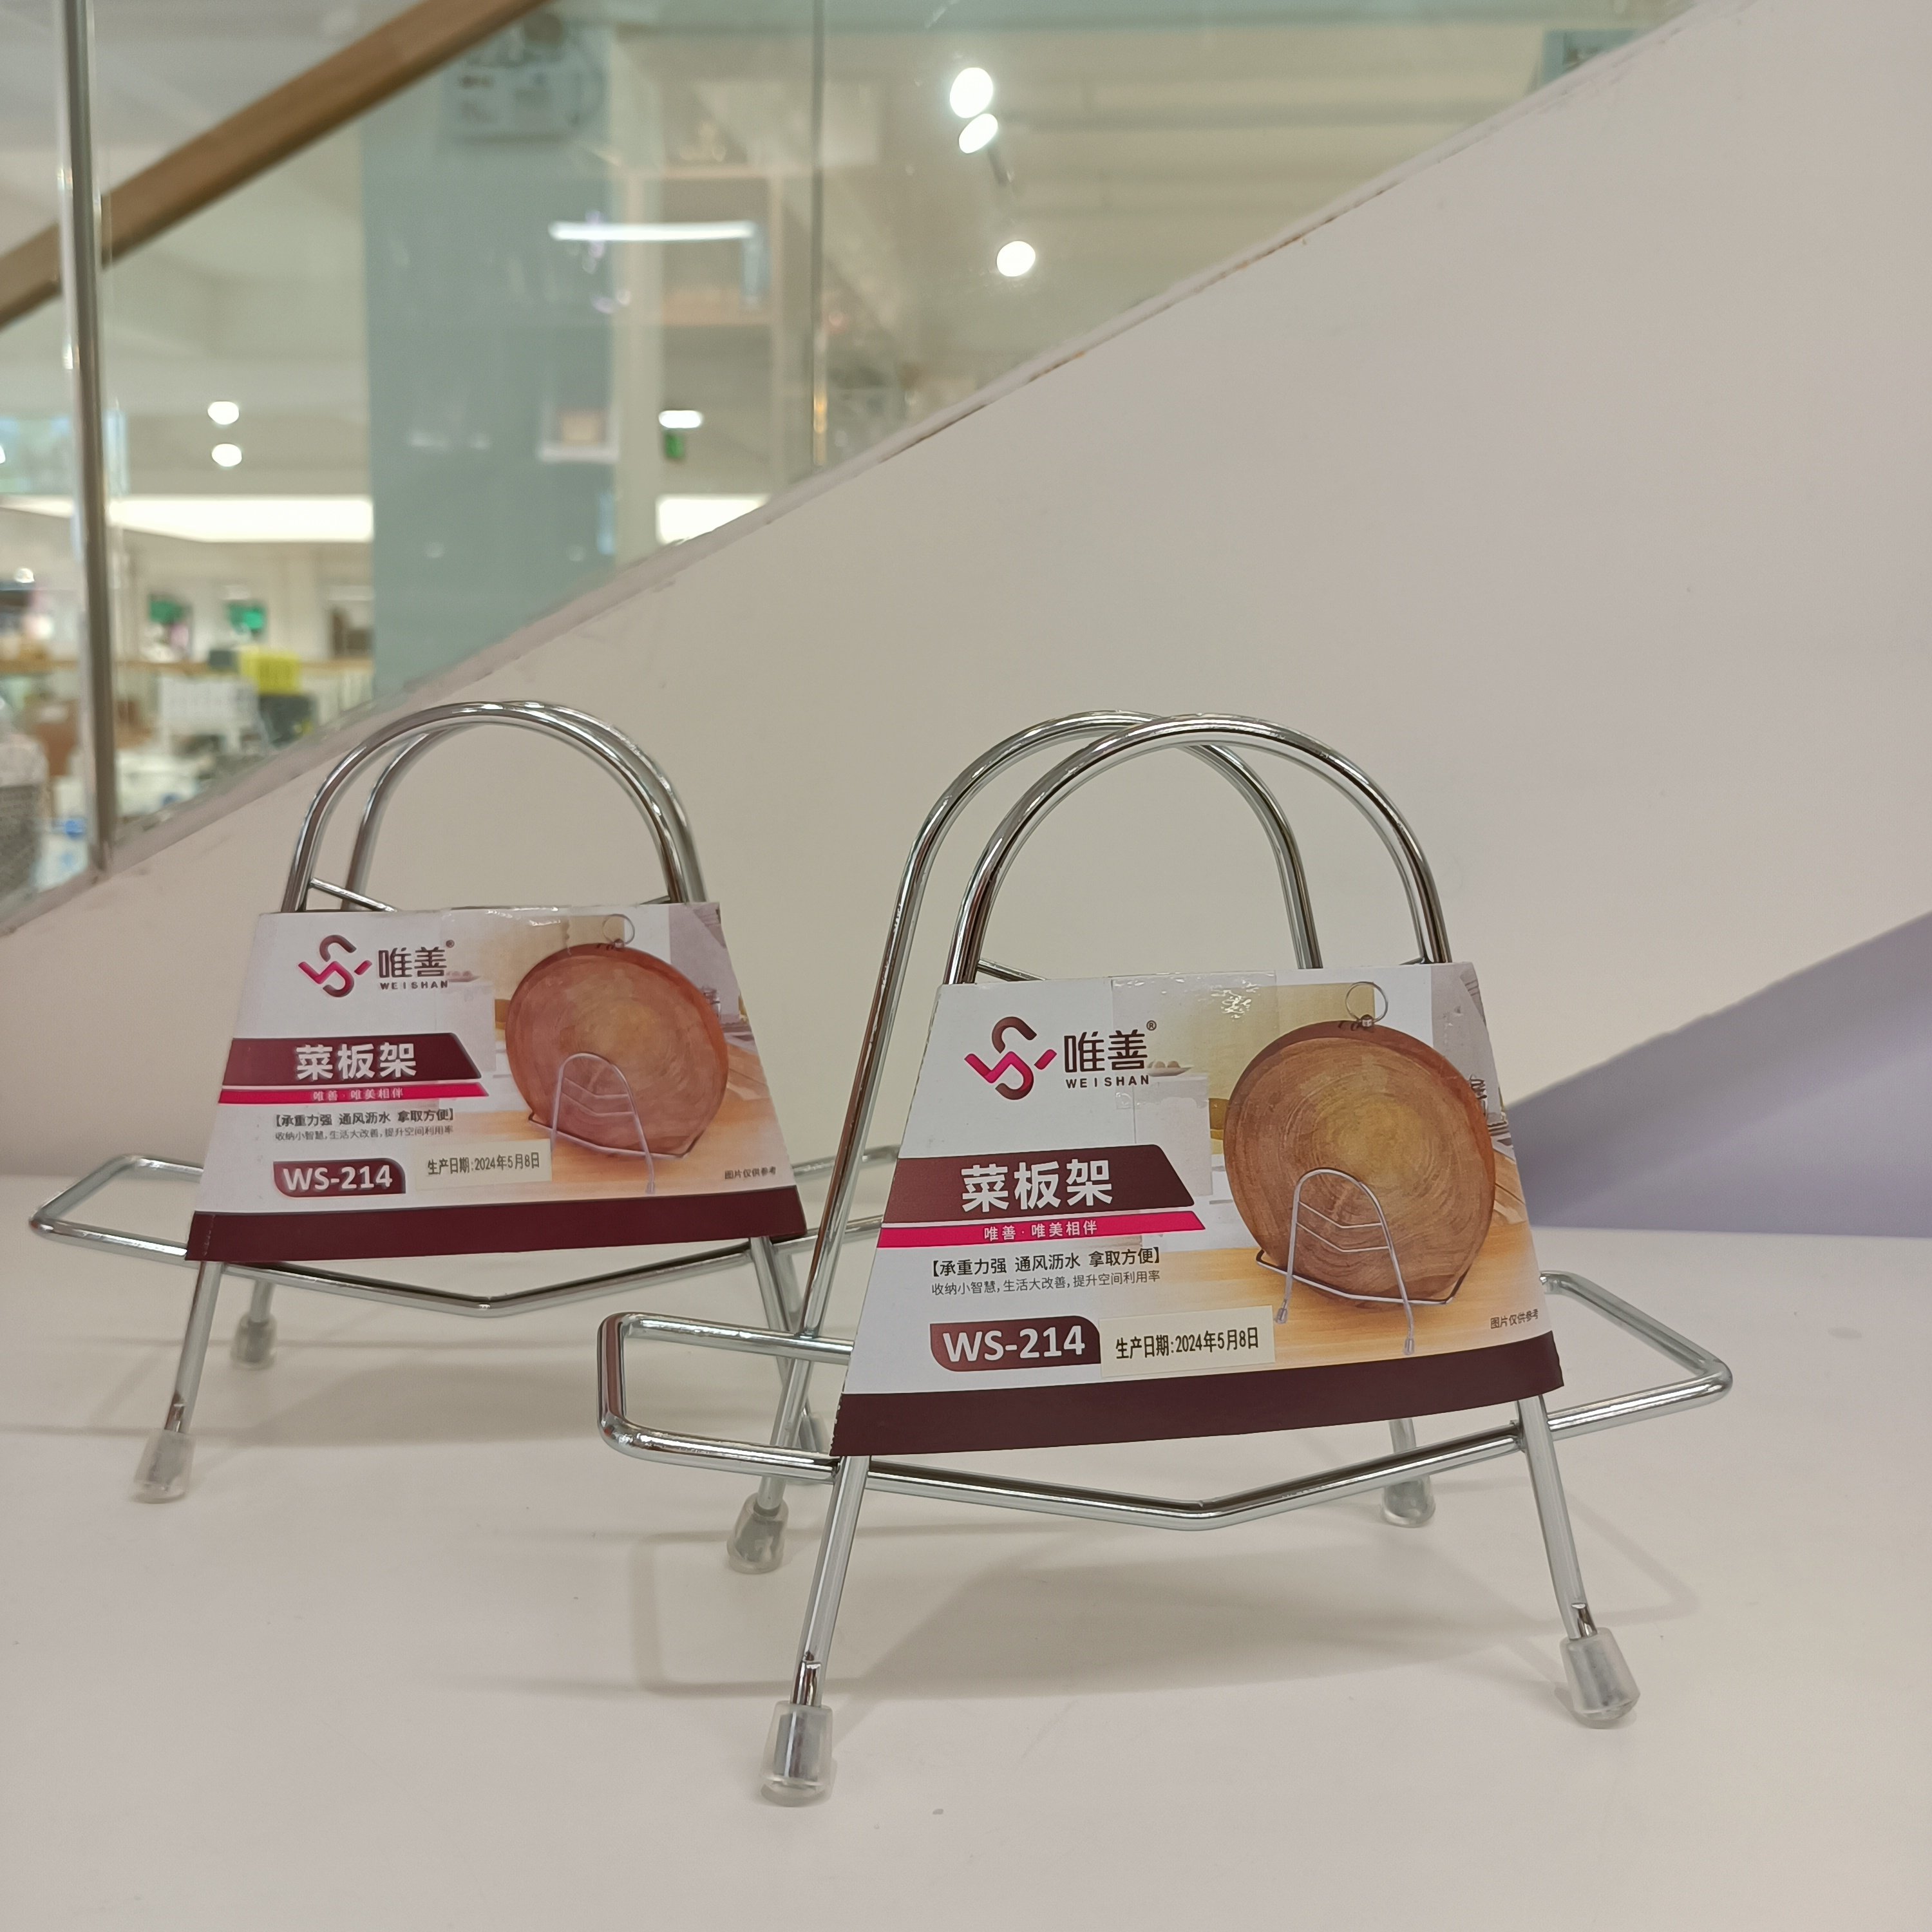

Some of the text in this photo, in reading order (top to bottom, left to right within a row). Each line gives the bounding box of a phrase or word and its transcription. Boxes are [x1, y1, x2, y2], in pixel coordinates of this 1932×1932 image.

[380, 980, 448, 990] WEISHAN
[296, 1042, 417, 1081] 菜板架
[1064, 1029, 1148, 1072] 唯善
[1066, 1075, 1149, 1088] WEISHAN
[283, 1165, 393, 1190] WS-214
[961, 1159, 1112, 1212] 菜板架
[943, 1325, 1085, 1362] WS-214
